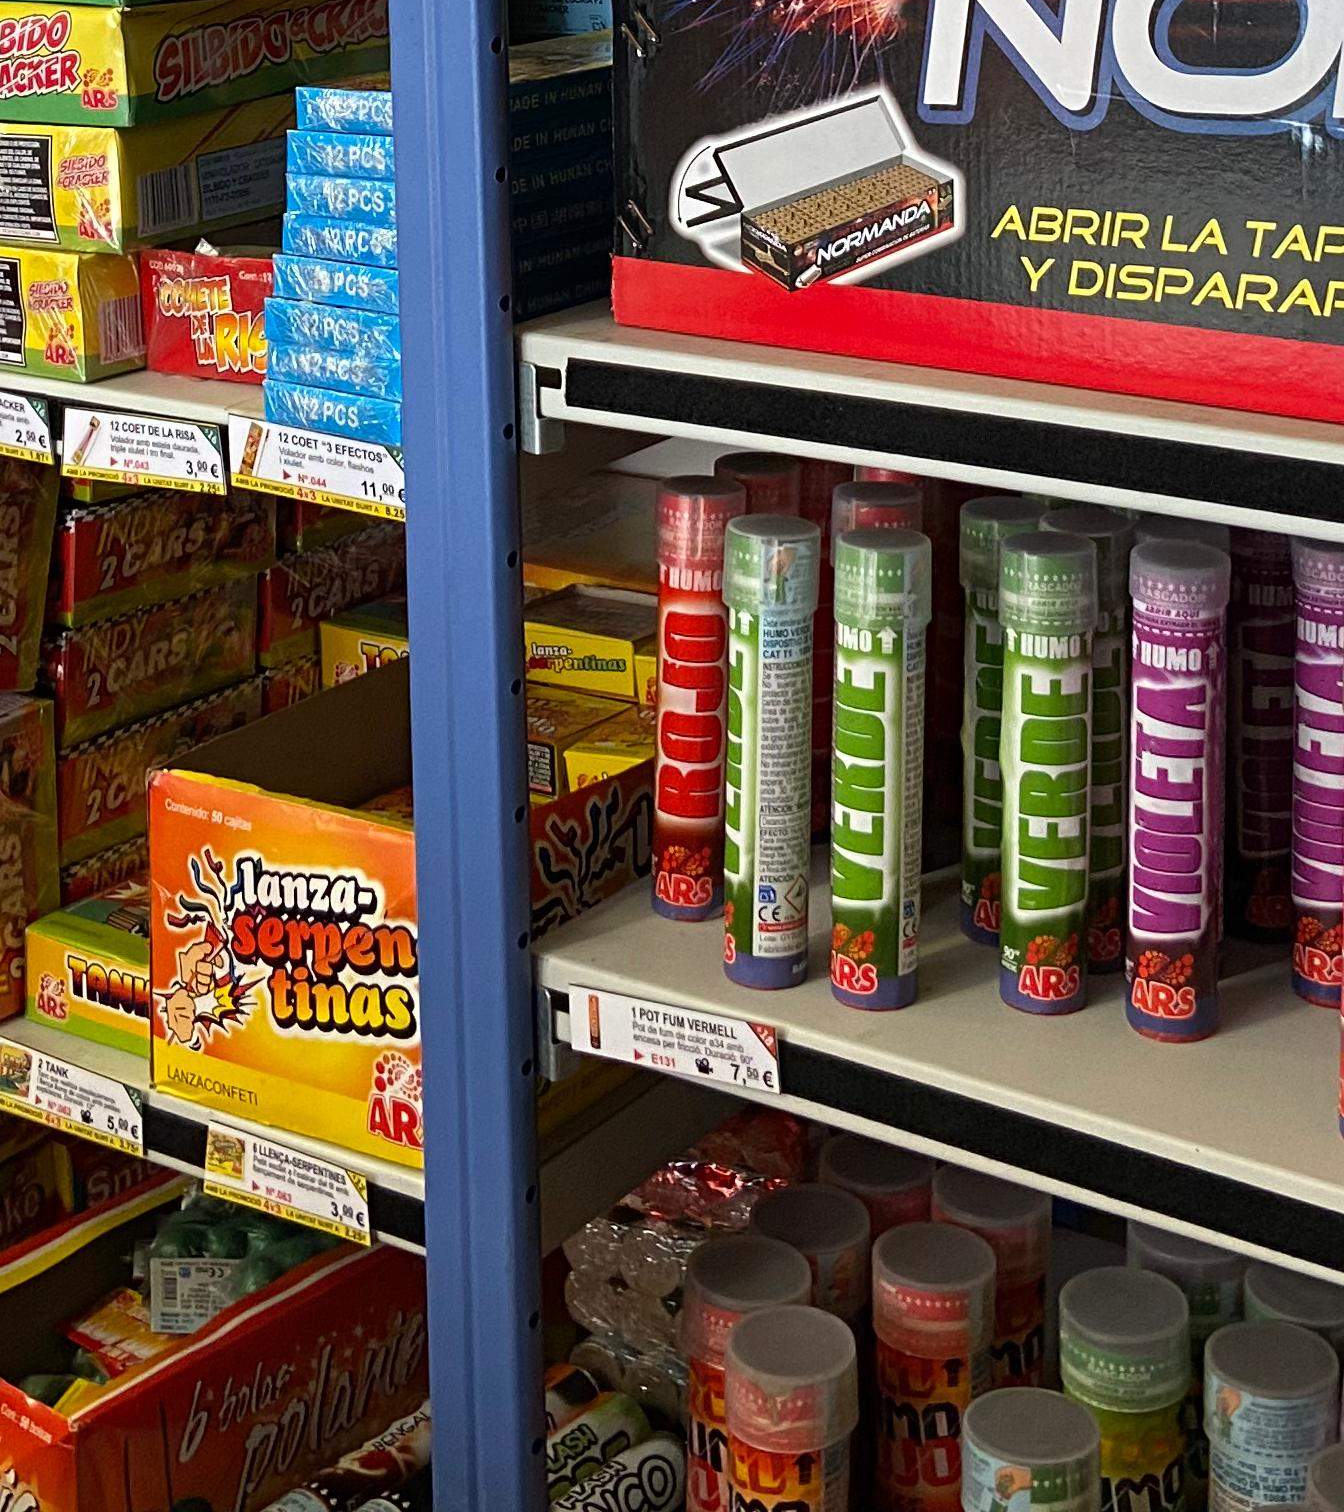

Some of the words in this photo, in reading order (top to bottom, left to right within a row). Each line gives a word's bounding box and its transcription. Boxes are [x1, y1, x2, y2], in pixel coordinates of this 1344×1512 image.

[815, 200, 932, 267] NORMANDA
[991, 204, 1154, 246] ABRIR
[1161, 212, 1243, 257] LA
[1021, 257, 1056, 292] Y
[110, 421, 119, 433] 12
[122, 422, 146, 435] COET
[149, 425, 160, 435] DE
[163, 427, 174, 438] LA
[176, 429, 197, 442] RISA
[1021, 632, 1080, 660] HUMO
[657, 610, 726, 818] ROJO
[832, 661, 887, 902] VERDE
[1017, 664, 1089, 913] VERDE
[1132, 682, 1207, 937] VIOLETA
[237, 857, 377, 918] lanza-
[231, 912, 418, 977] serpen
[267, 967, 417, 1038] tinas
[1017, 965, 1080, 1001] ARS
[631, 1007, 636, 1018] 1
[639, 1008, 659, 1024] POT
[663, 1013, 685, 1029] FUM
[687, 1018, 738, 1039] VERMELL
[38, 1058, 44, 1069] 2
[45, 1060, 69, 1079] TANK
[651, 1052, 676, 1068] E131
[763, 1071, 774, 1088] €
[167, 1065, 259, 1106] LANZACONFETI
